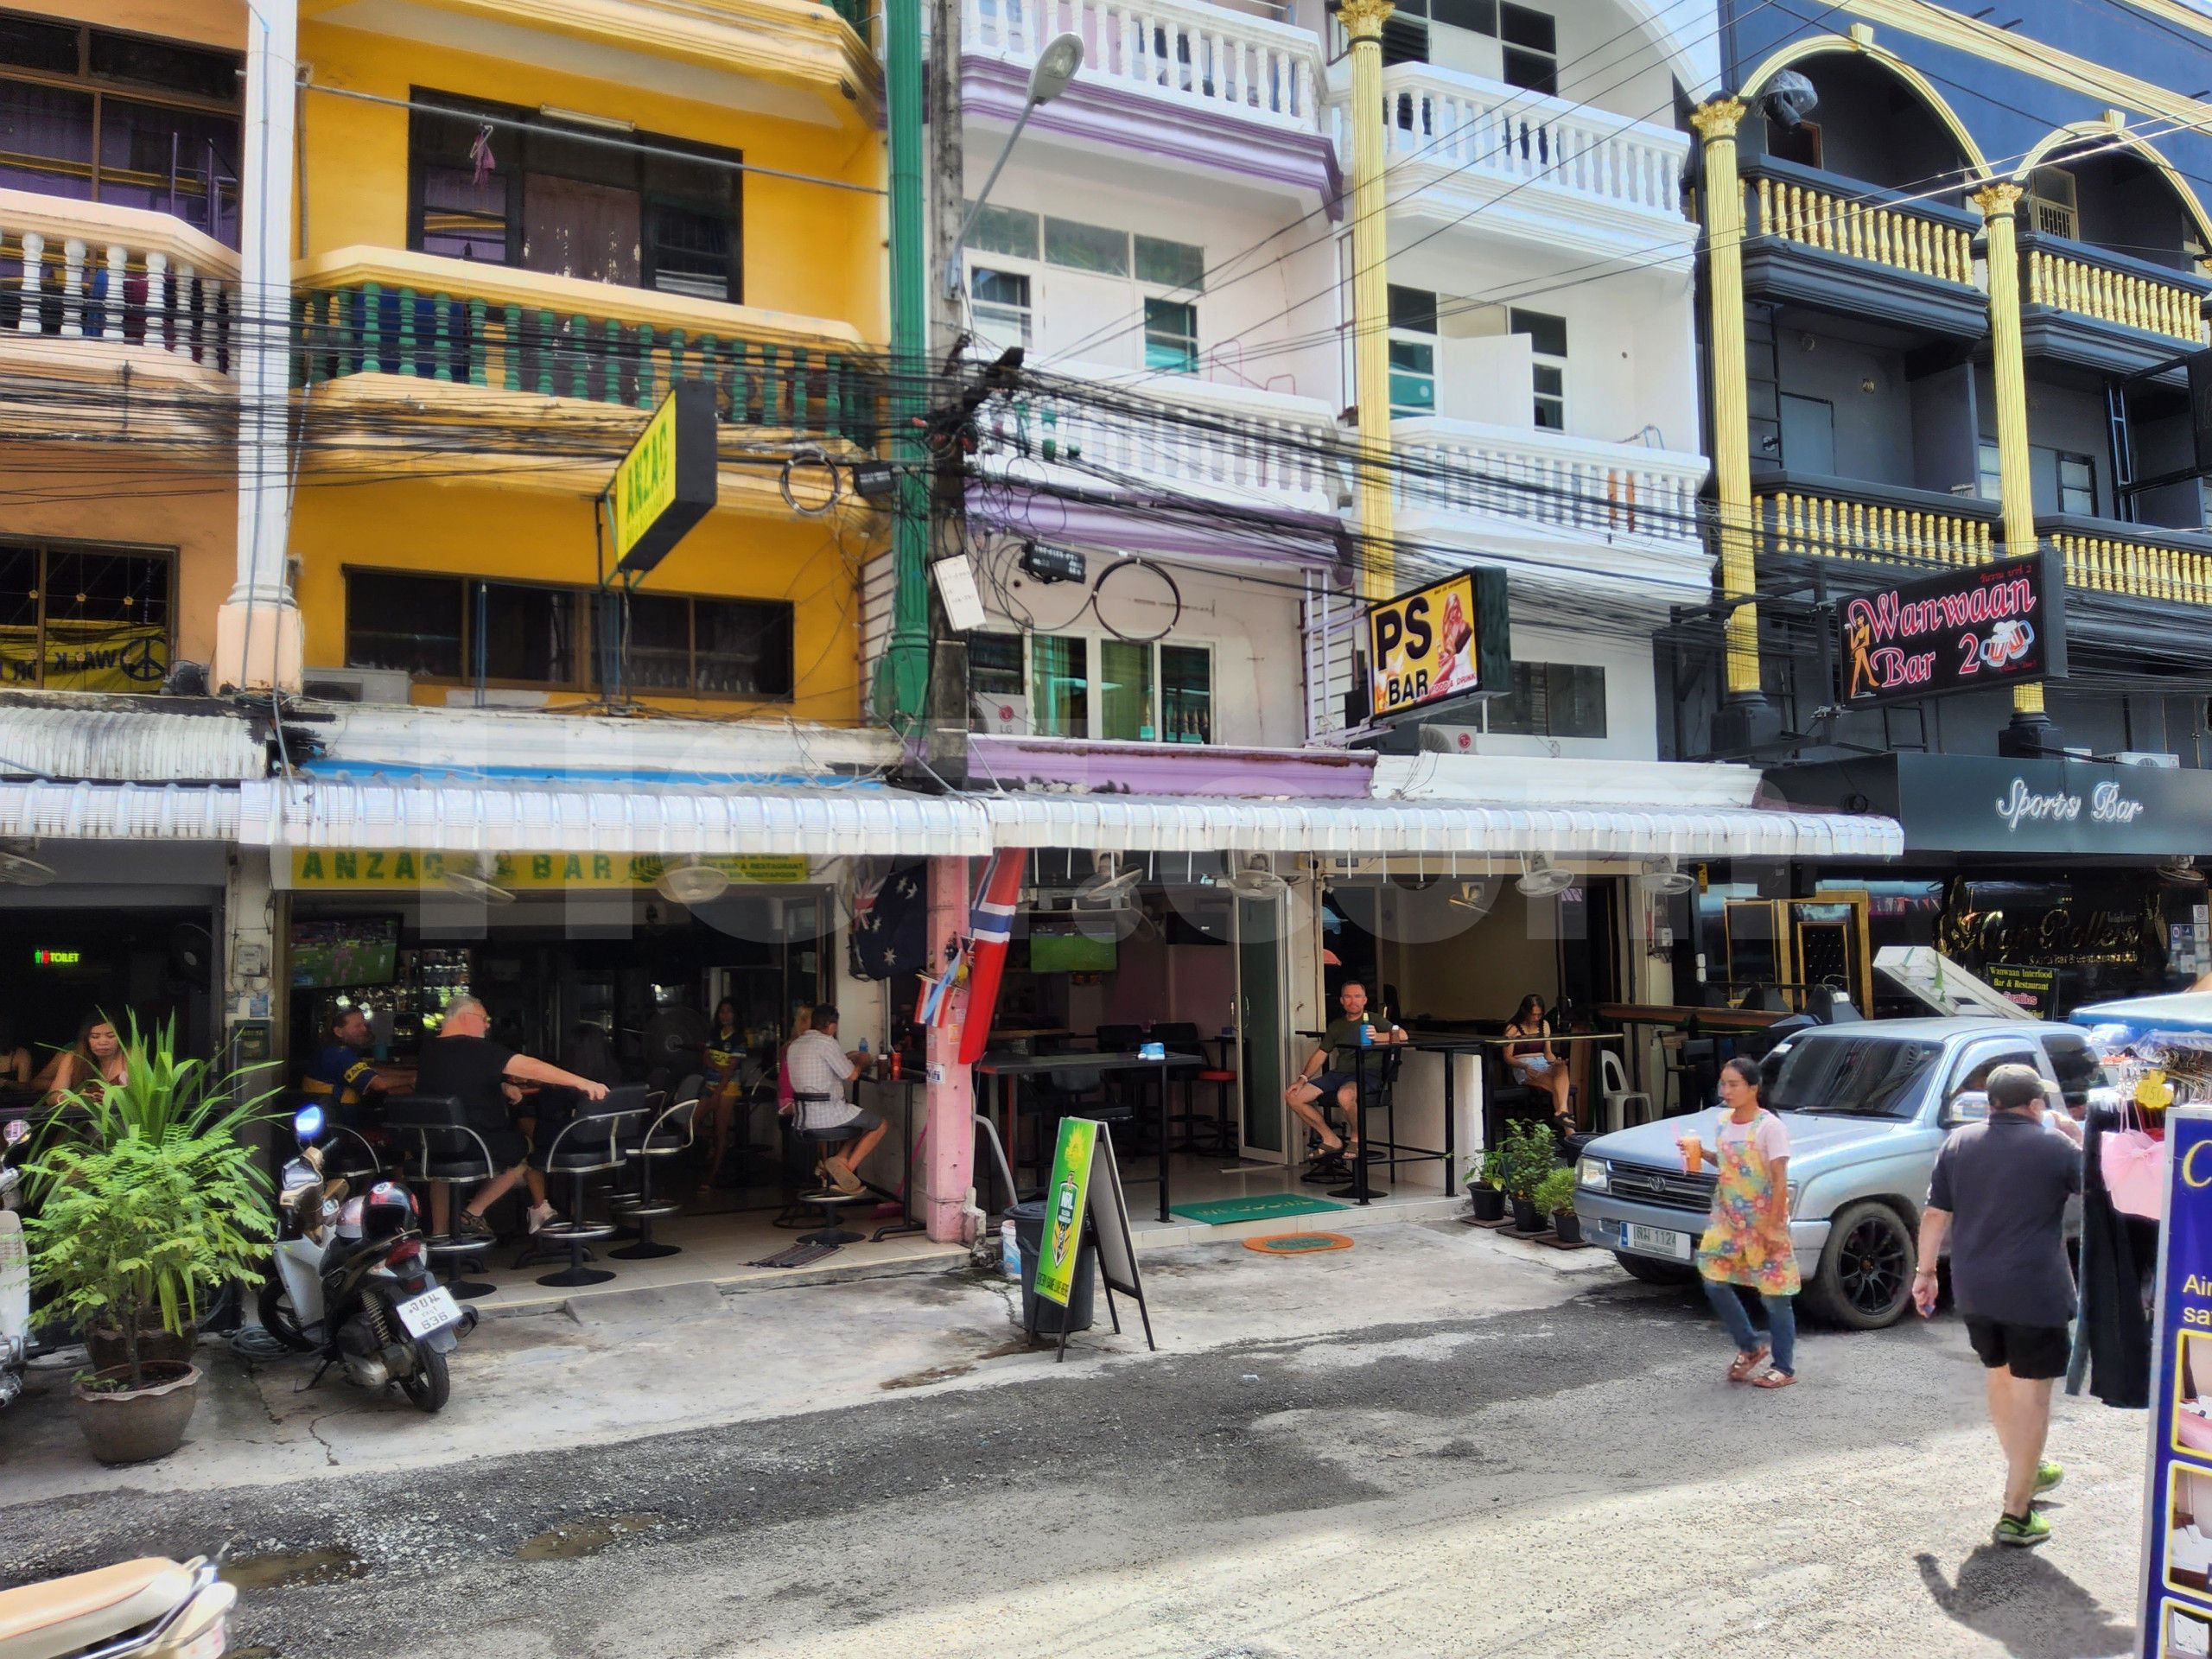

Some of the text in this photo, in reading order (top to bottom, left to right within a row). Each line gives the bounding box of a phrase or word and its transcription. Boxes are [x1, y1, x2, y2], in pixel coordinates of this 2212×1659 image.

[1848, 578, 2037, 644] Wanwaan
[1376, 596, 1433, 672] PS
[1870, 632, 1981, 689] Bar 2
[1388, 668, 1429, 707] BAR
[1995, 776, 2145, 833] Sports Bar
[531, 851, 614, 880] BAR
[49, 952, 79, 963] TOILET
[1989, 966, 2054, 979] Wanwaan Interfood
[2014, 980, 2050, 991] Restaurant
[2183, 1306, 2212, 1327] sa
